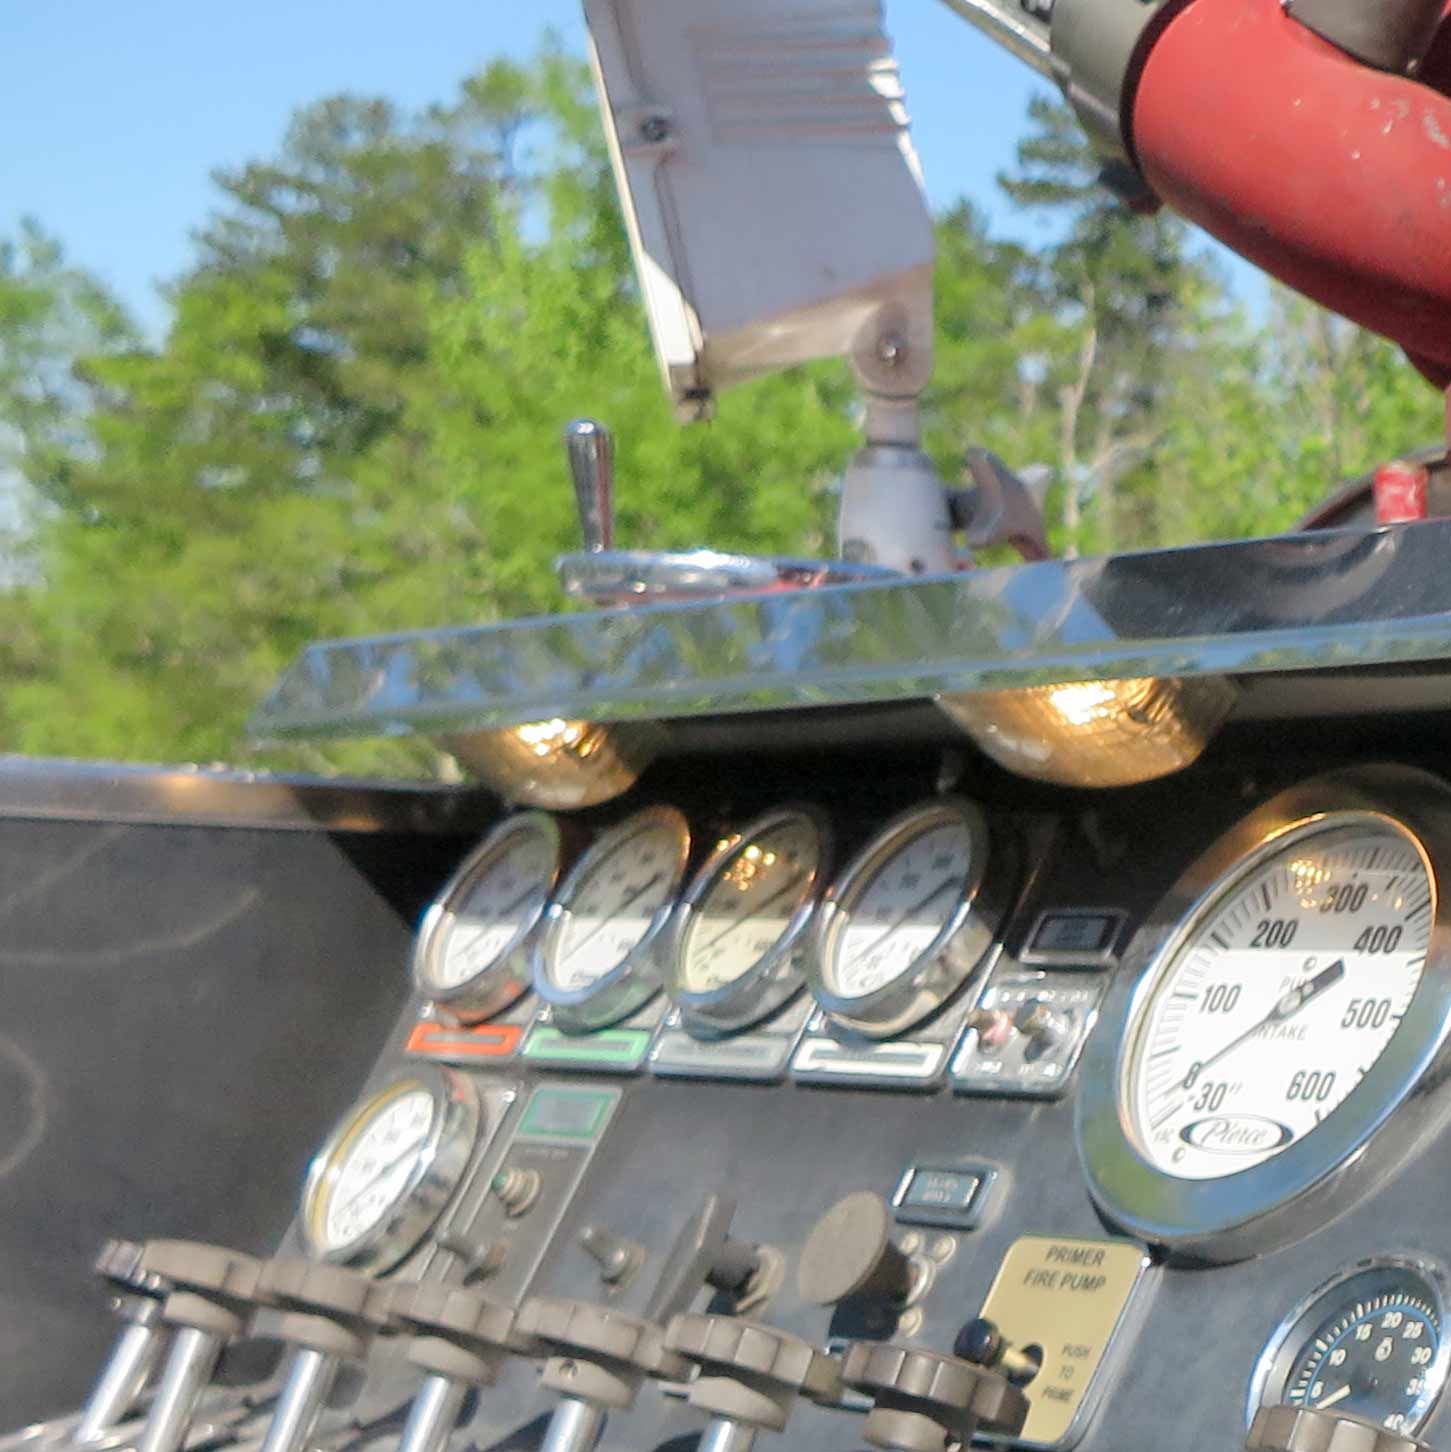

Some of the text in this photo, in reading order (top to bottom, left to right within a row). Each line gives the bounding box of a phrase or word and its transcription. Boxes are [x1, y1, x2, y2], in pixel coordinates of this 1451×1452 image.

[1319, 883, 1368, 913] 300
[1250, 919, 1299, 950] 200
[1352, 925, 1403, 955] 400
[1199, 984, 1241, 1014] 100
[1341, 998, 1392, 1029] 500
[1285, 1071, 1336, 1102] 600
[1200, 1120, 1268, 1144] Pierce
[1045, 1247, 1107, 1266] PRIMER
[1023, 1268, 1107, 1291] FIRE PUMP
[1381, 1311, 1403, 1329] 20
[1402, 1321, 1425, 1339] 25
[1355, 1323, 1373, 1341] 15
[1329, 1349, 1347, 1367] 10
[1410, 1346, 1432, 1365] 30
